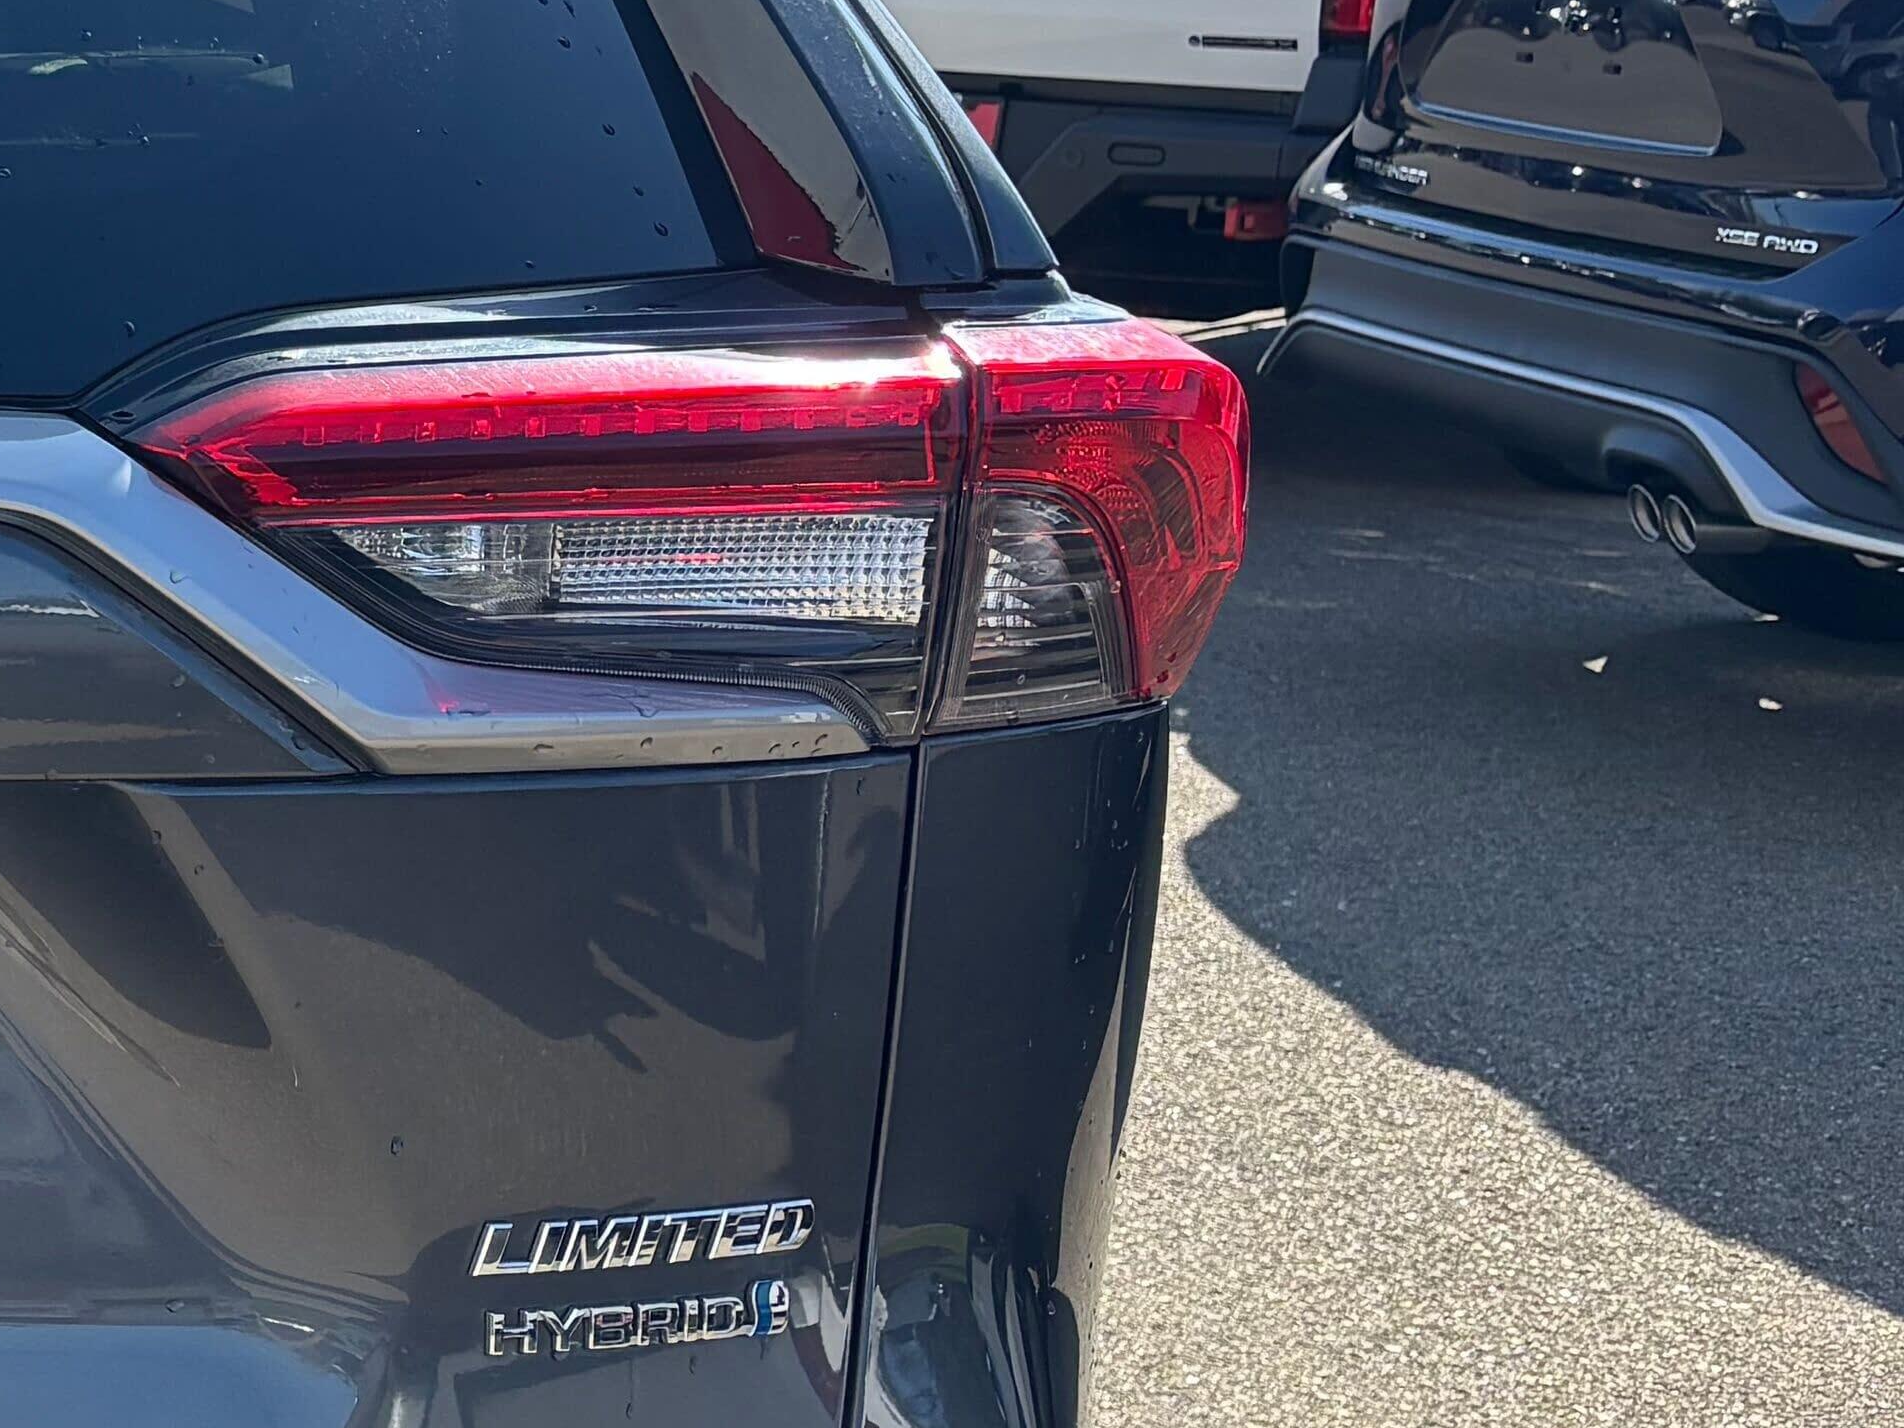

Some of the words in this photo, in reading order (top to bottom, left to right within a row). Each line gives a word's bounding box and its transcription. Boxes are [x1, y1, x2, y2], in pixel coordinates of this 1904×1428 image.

[1715, 227, 1760, 247] XSE
[1763, 235, 1819, 254] AWD
[470, 1198, 817, 1276] LIMITED
[484, 1295, 746, 1356] HYBRID
